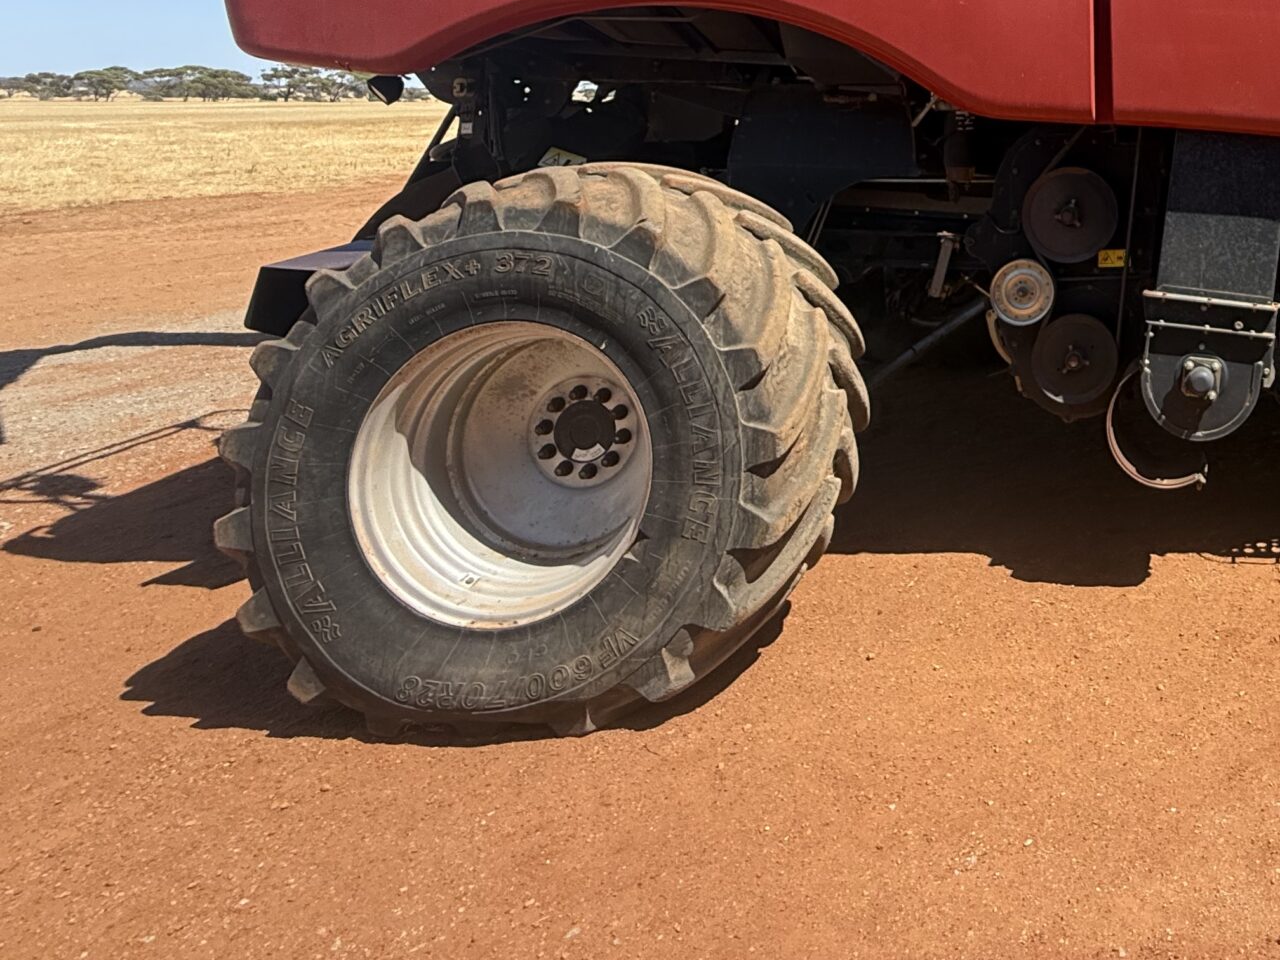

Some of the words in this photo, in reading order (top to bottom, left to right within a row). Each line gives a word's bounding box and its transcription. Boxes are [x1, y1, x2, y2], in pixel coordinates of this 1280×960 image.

[320, 258, 481, 369] AGRIFLEX+
[494, 252, 555, 276] 372
[268, 398, 337, 615] ALLIANCE
[647, 333, 722, 544] ALLIANCE
